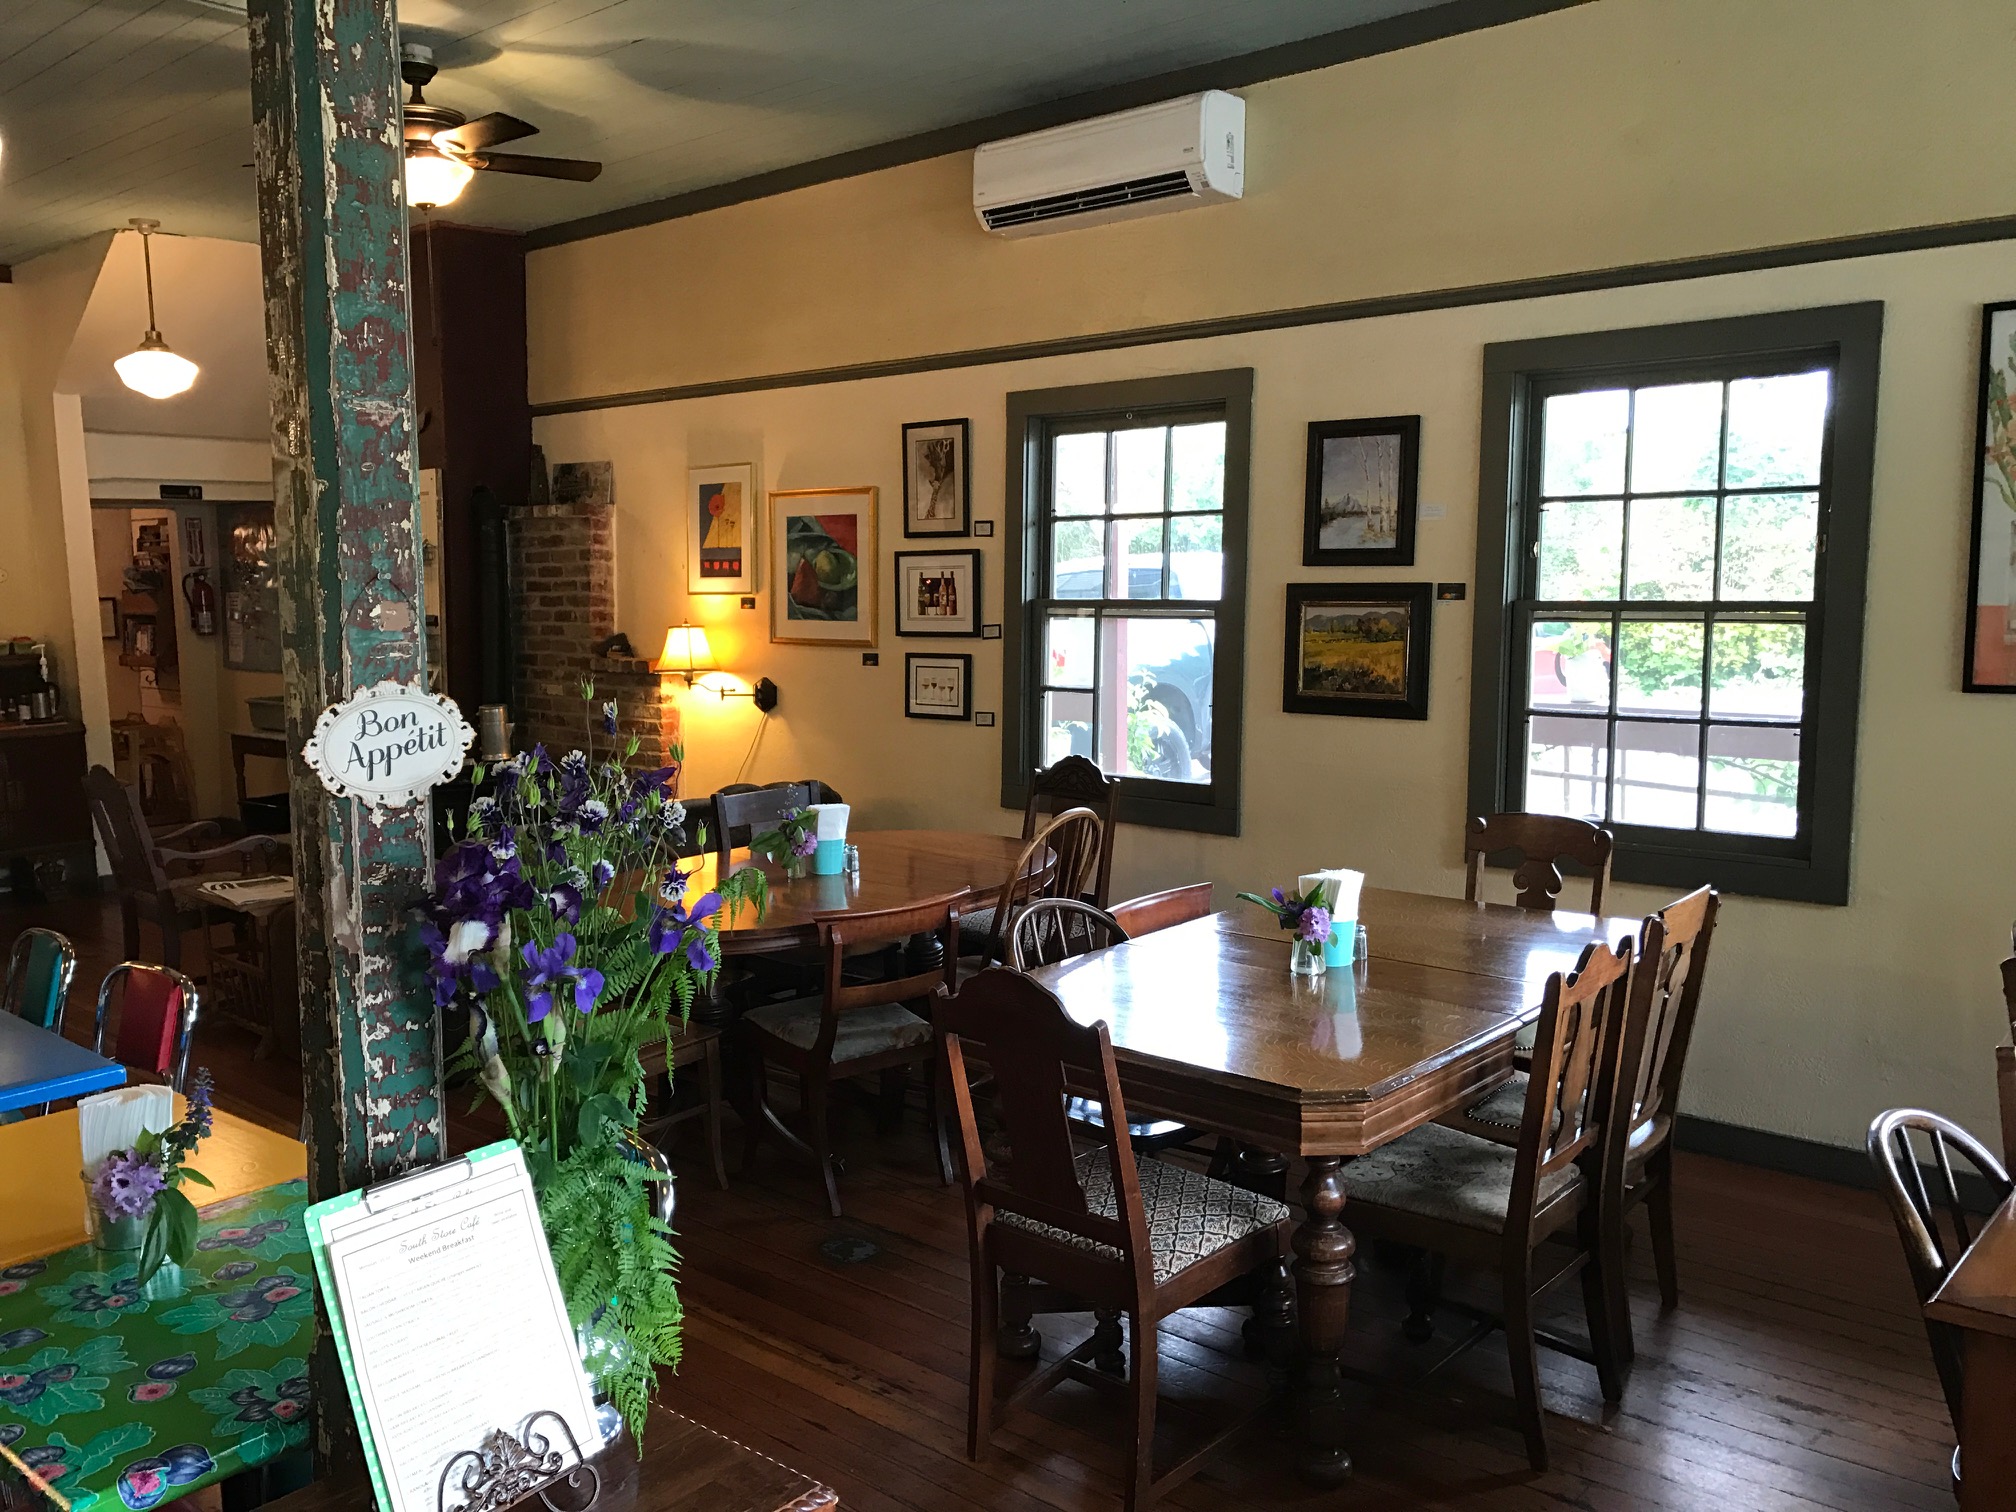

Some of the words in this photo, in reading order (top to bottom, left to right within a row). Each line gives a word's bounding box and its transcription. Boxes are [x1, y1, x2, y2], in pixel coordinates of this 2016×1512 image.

[354, 709, 419, 741] Bon
[342, 722, 447, 781] Appétit
[399, 1233, 427, 1254] South
[431, 1227, 456, 1241] Store
[460, 1215, 480, 1231] Café
[408, 1247, 441, 1264] Weekend
[442, 1235, 474, 1251] Breakfast
